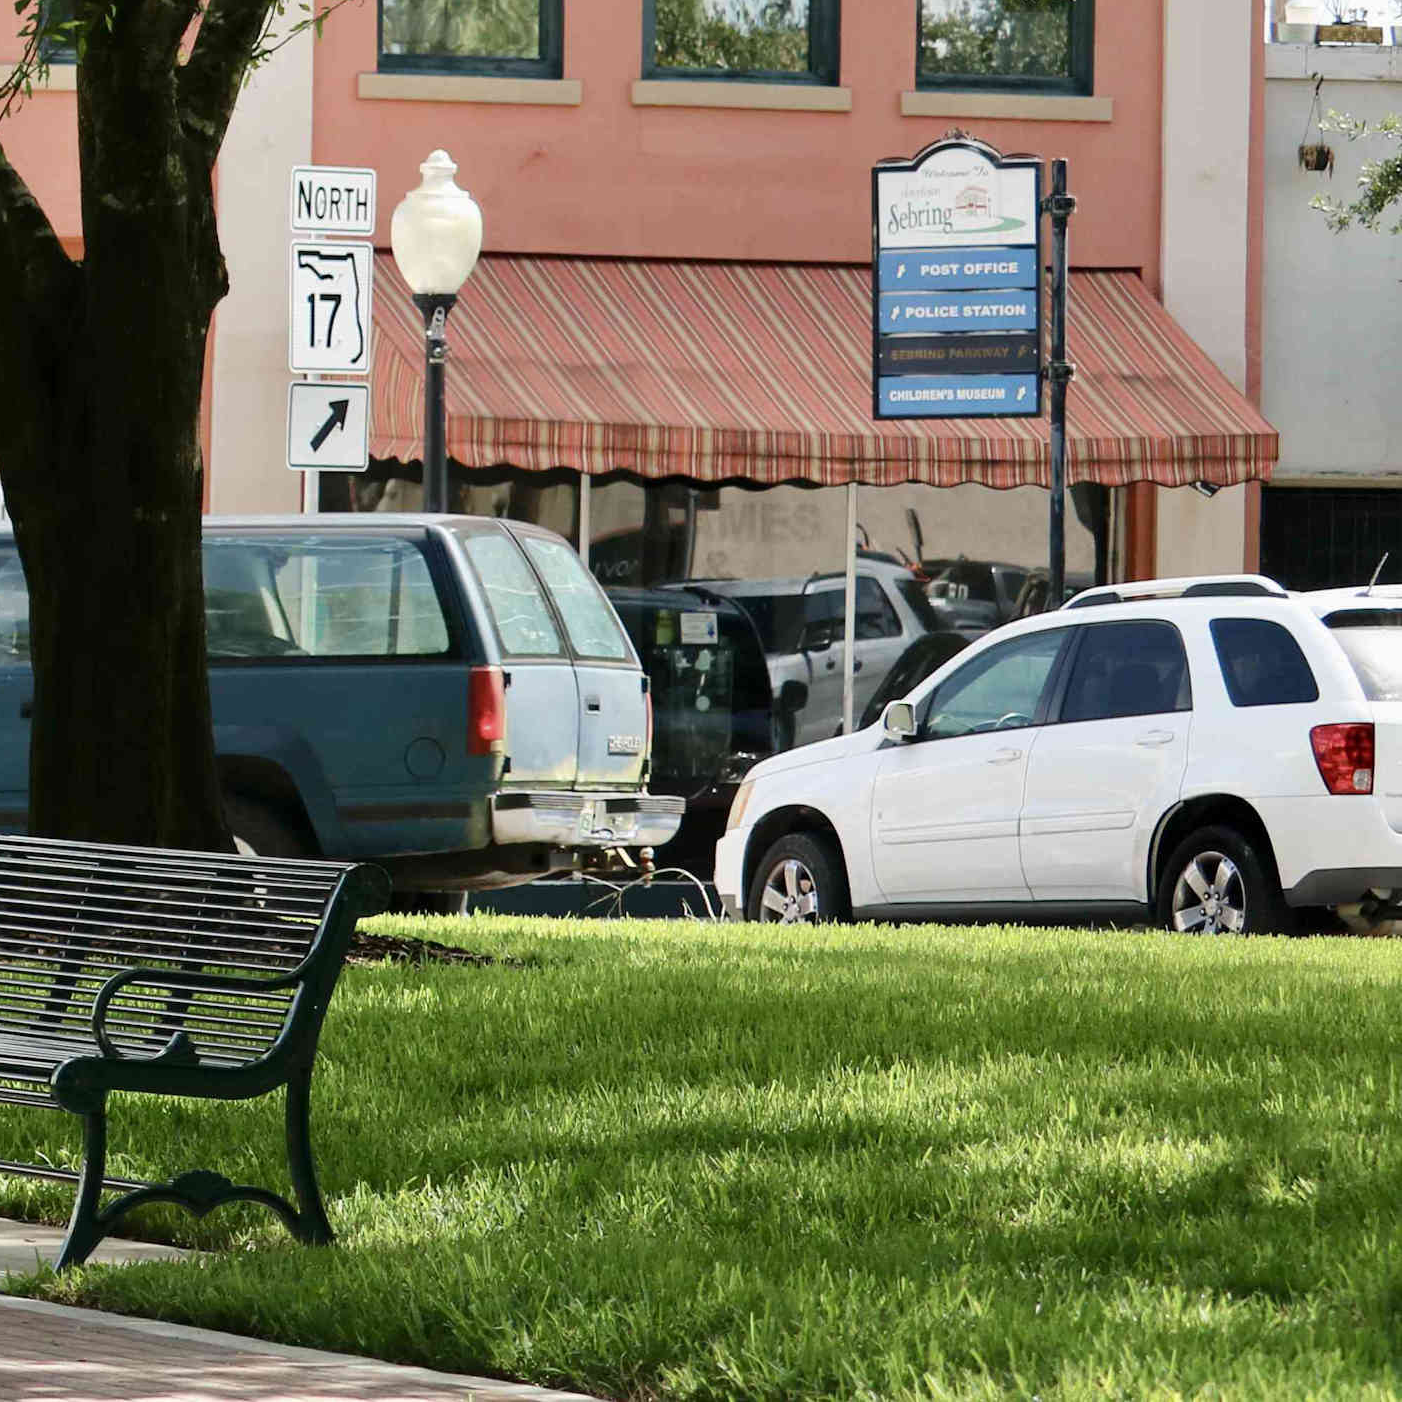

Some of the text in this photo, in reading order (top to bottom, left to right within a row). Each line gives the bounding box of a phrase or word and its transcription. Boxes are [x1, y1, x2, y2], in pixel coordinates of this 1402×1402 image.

[921, 166, 990, 179] Welcome To
[297, 180, 368, 221] NORTH
[888, 202, 954, 234] Sebring
[920, 262, 1019, 276] POST OFFICE
[905, 304, 1026, 318] POLICE STATION
[308, 293, 342, 348] 17
[890, 346, 1010, 361] SEBRING PARKWAY
[889, 387, 1006, 402] CHILDREN'S MUSEUM
